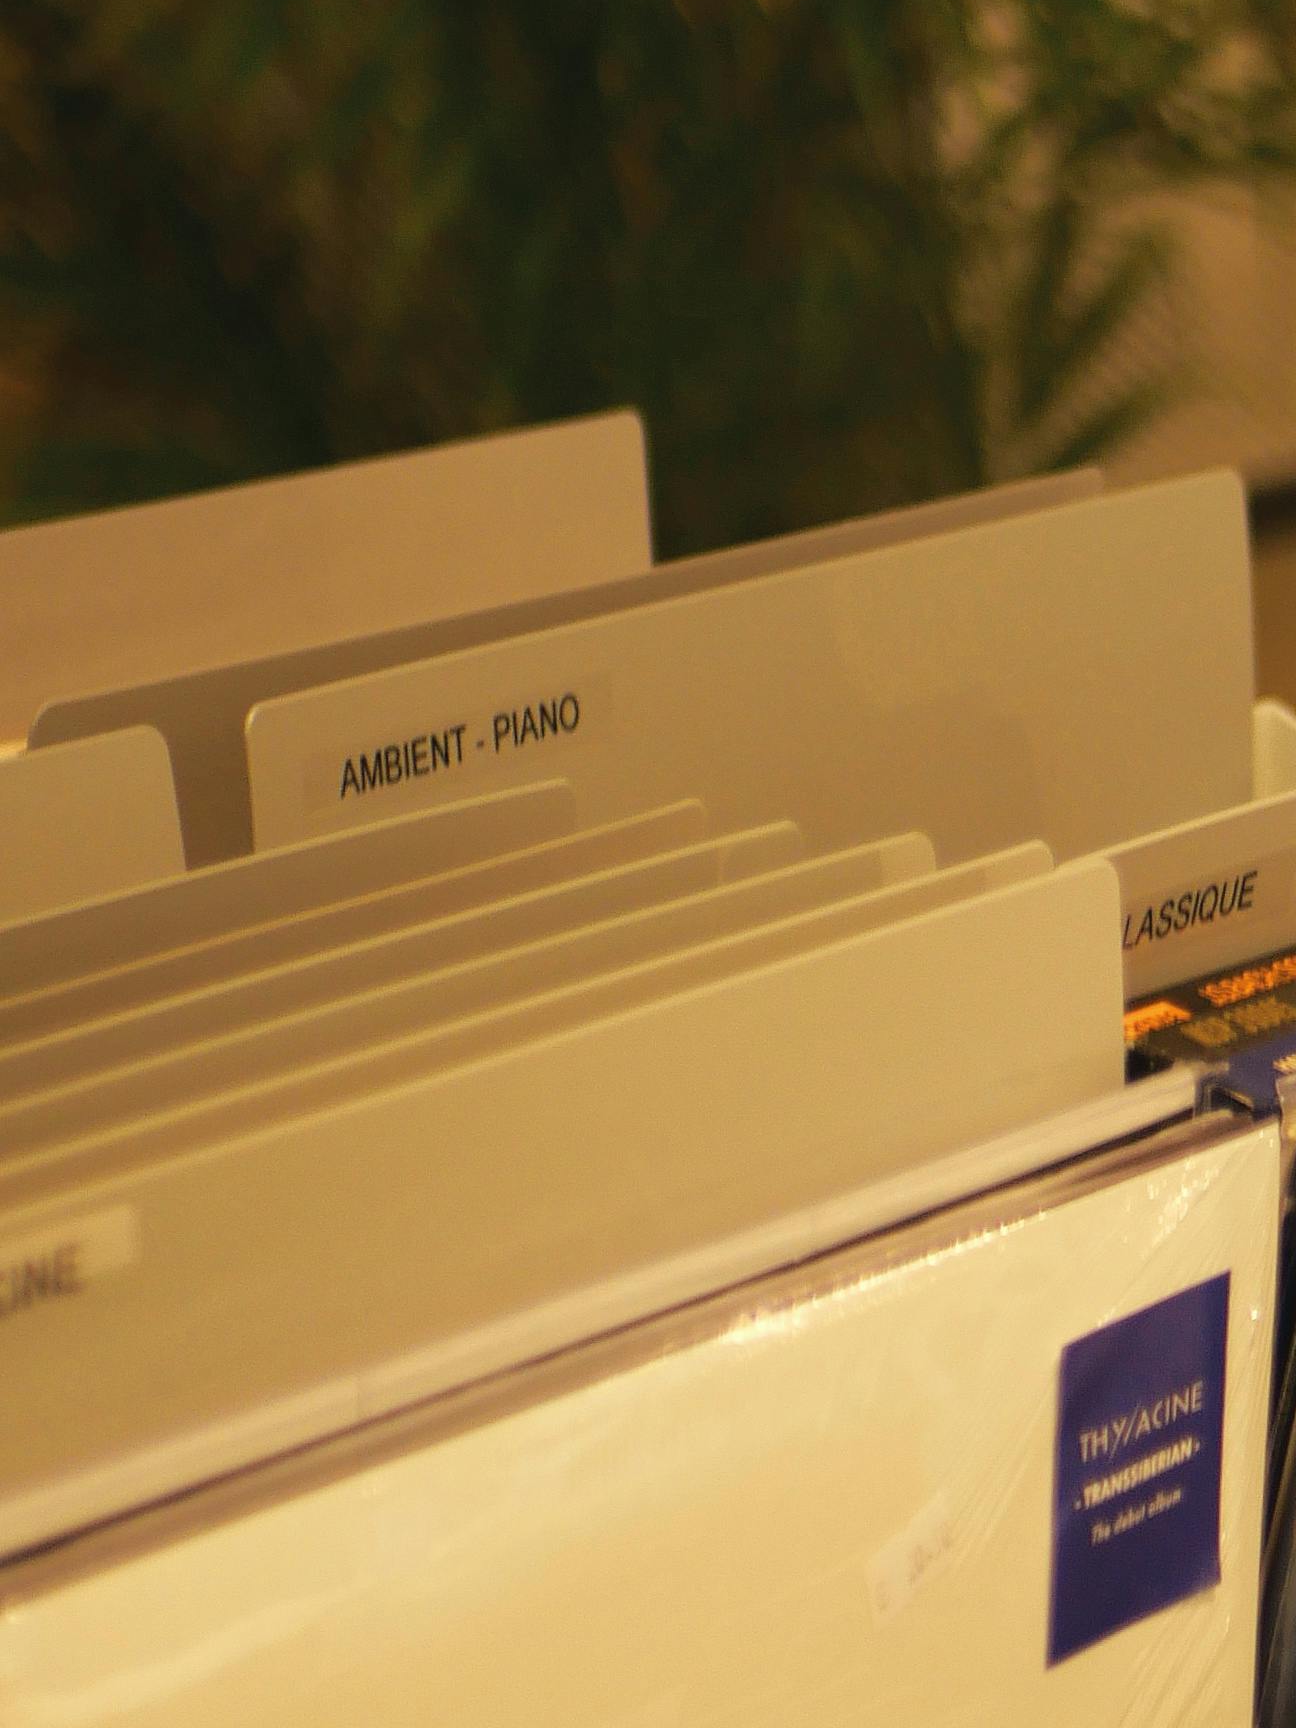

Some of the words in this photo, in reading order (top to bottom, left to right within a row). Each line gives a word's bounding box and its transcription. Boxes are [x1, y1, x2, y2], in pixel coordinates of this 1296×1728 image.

[338, 723, 467, 800] AMBIENT
[492, 692, 580, 754] PIANO
[1122, 869, 1259, 951] LASSIQUE
